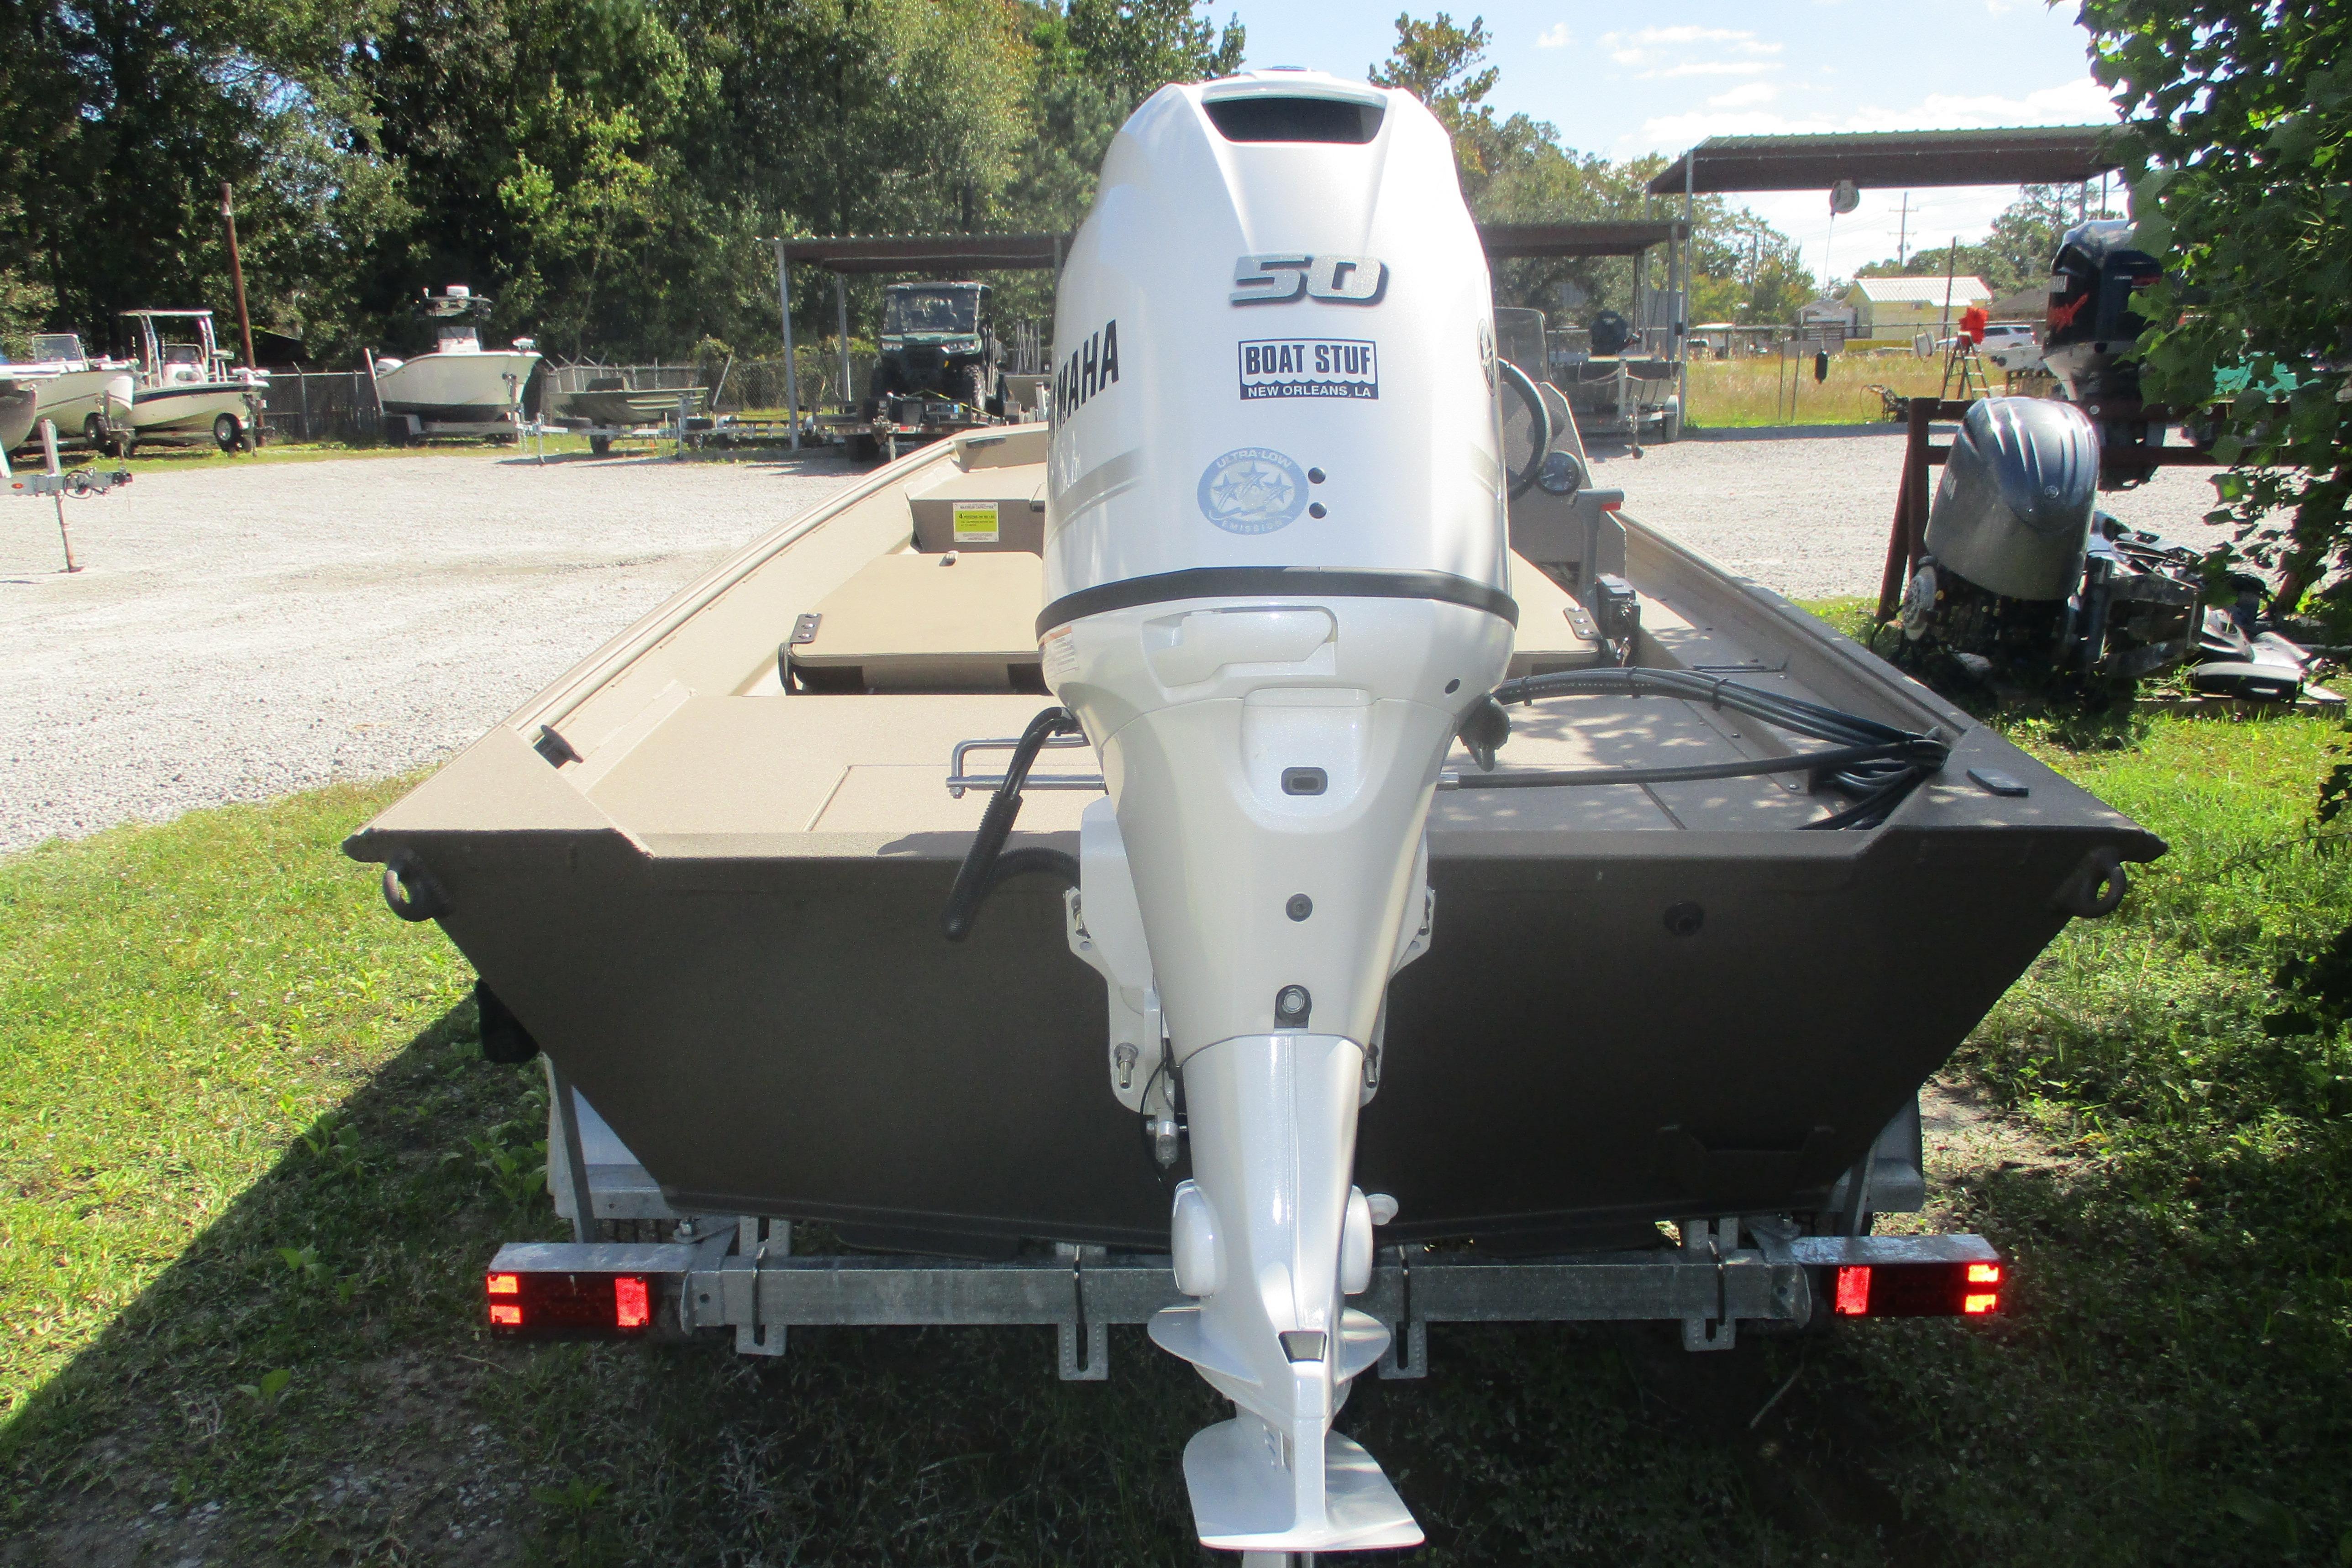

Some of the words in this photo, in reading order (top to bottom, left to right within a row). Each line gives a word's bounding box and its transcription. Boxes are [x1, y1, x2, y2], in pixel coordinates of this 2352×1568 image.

[1229, 253, 1389, 308] 50
[1049, 318, 1119, 442] MAHA
[1245, 345, 1305, 375] BOAT
[1315, 344, 1370, 375] STUF
[1248, 386, 1278, 397] NEW
[1282, 385, 1352, 398] ORLEANS,
[1354, 387, 1371, 397] LA
